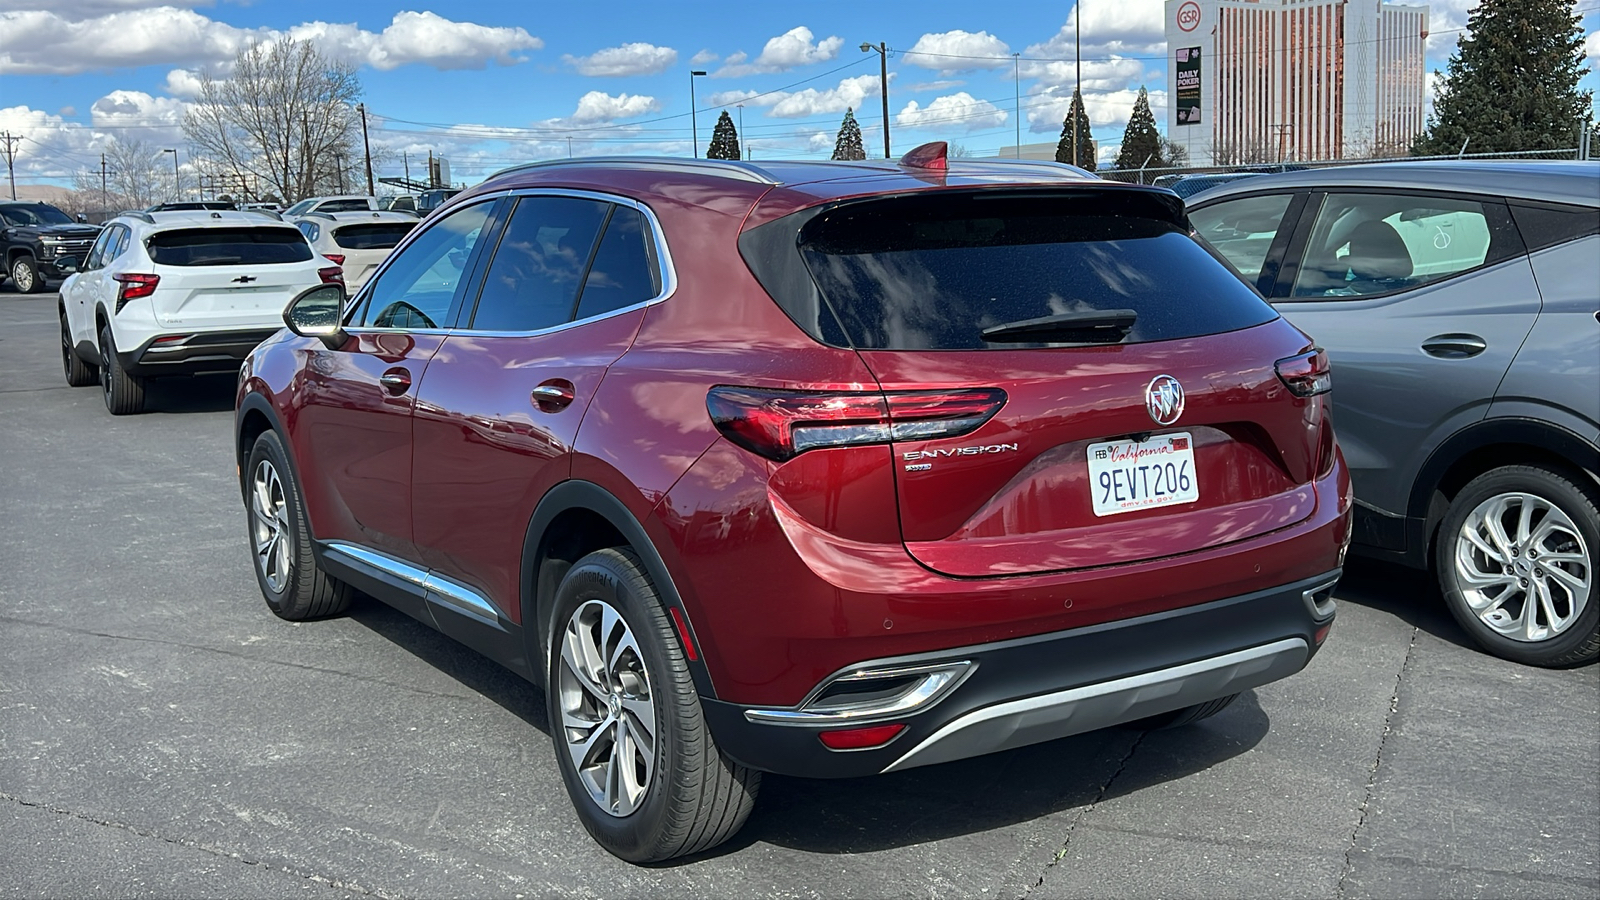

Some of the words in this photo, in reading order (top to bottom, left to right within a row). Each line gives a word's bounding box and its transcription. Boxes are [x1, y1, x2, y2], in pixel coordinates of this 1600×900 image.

[1180, 10, 1197, 23] GSR
[1178, 69, 1199, 79] DAILY
[1177, 77, 1199, 86] POKER
[903, 443, 1018, 461] ENVISION
[1095, 449, 1108, 460] FEB
[1111, 443, 1174, 464] California
[1099, 459, 1190, 505] 9EVT206
[1121, 496, 1173, 508] dmv.ca.gov
